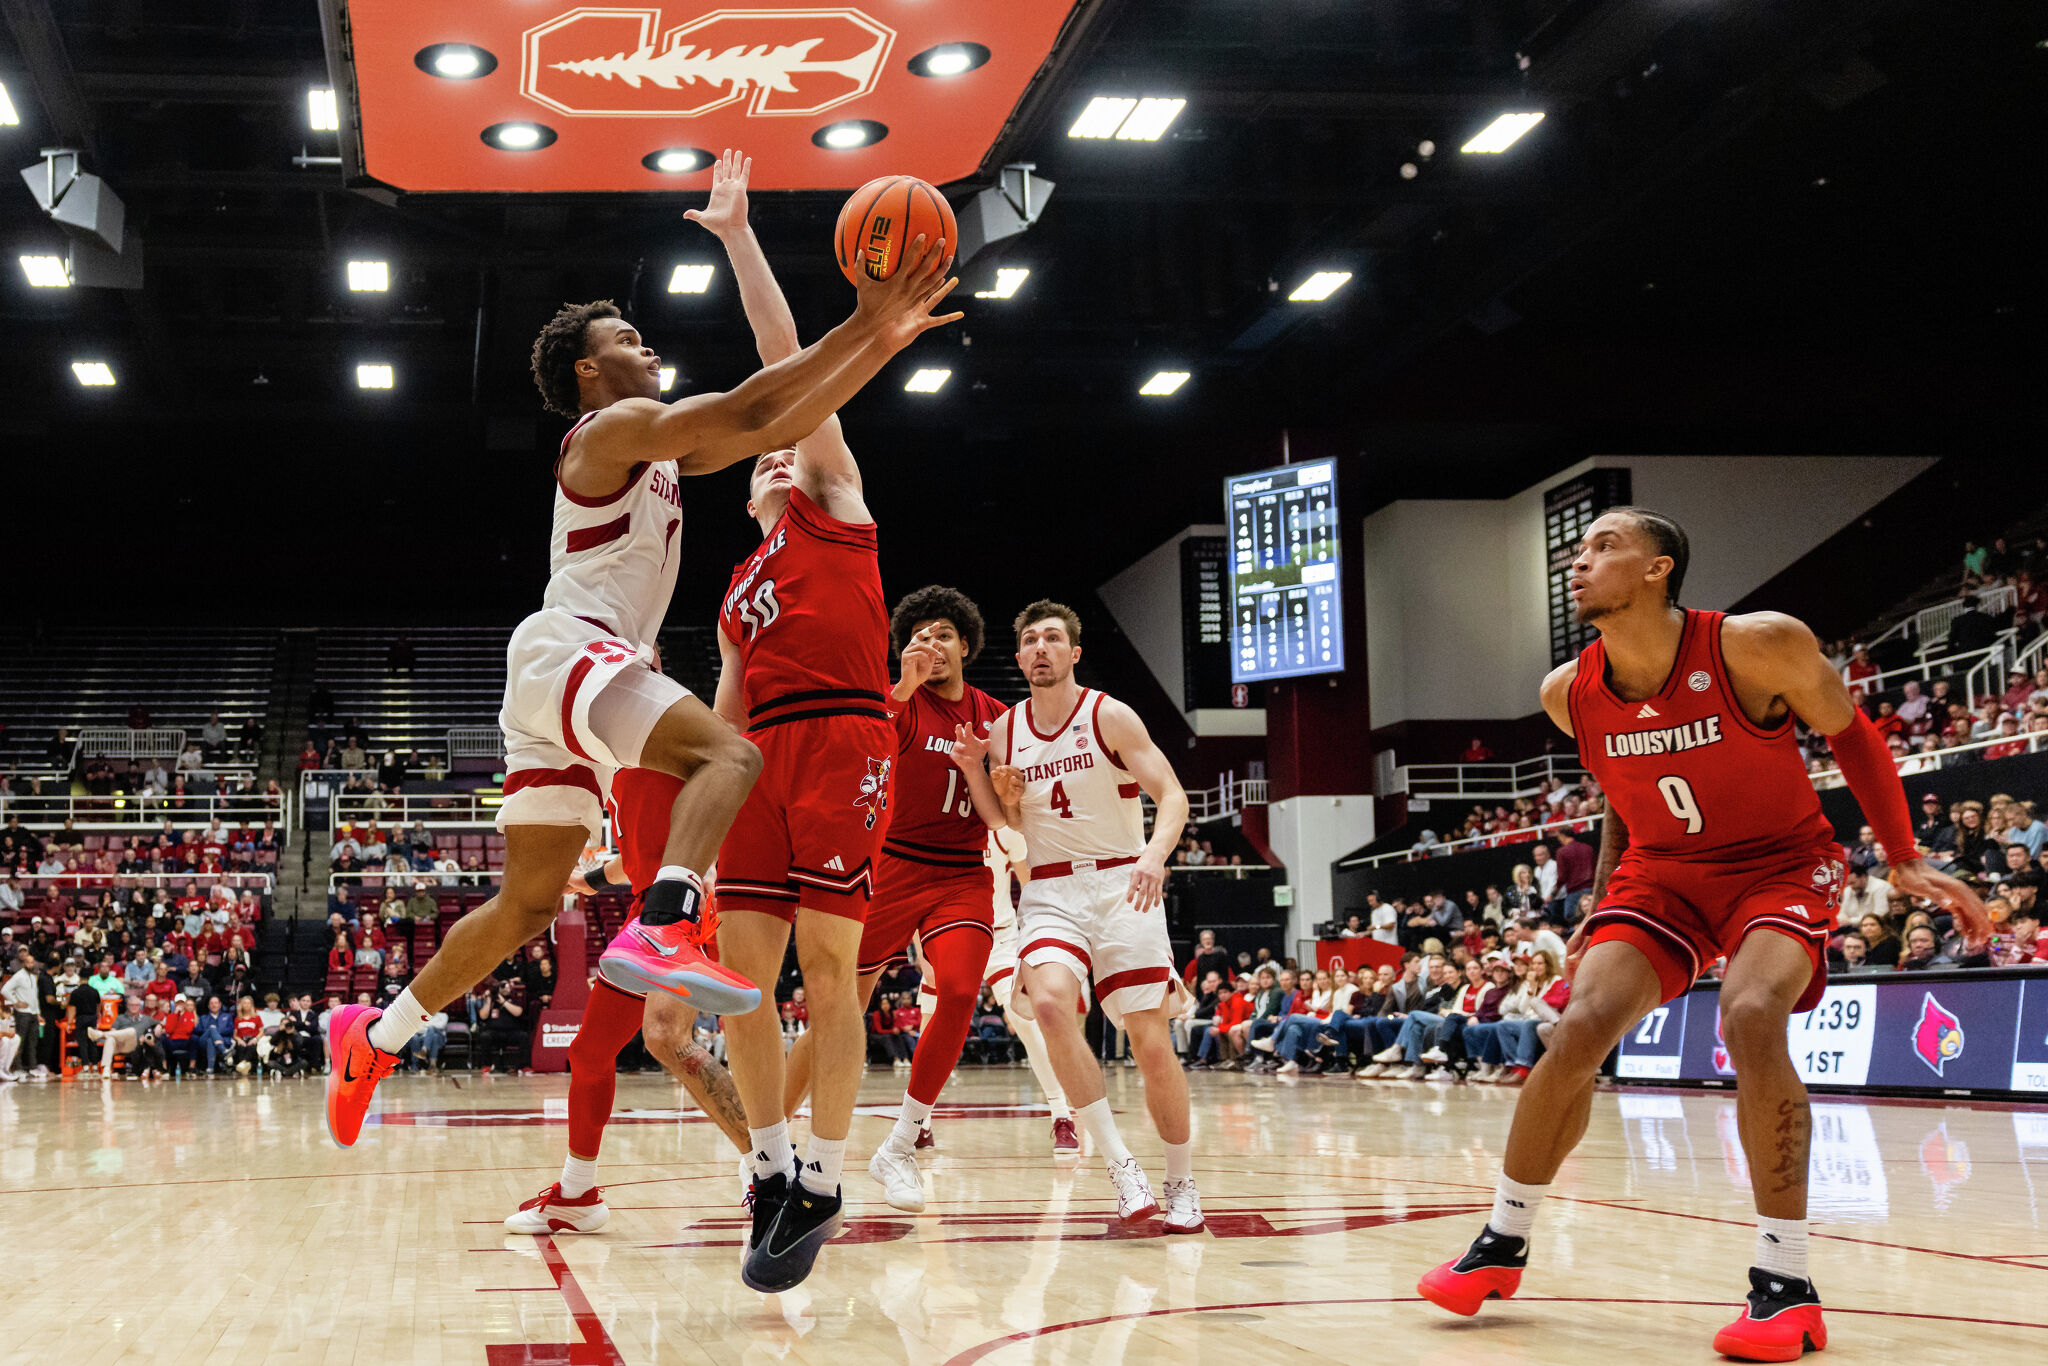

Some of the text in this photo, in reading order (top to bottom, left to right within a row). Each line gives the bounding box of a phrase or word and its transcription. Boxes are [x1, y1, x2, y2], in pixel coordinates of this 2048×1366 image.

[866, 216, 891, 281] ELITE
[1264, 509, 1272, 520] 7
[1290, 505, 1299, 516] 2
[1264, 522, 1273, 533] 2
[1291, 530, 1300, 541] 3
[724, 528, 786, 624] LOUISVLE
[1320, 600, 1329, 611] 2
[1268, 632, 1277, 643] 2
[1269, 656, 1277, 668] 7
[1605, 715, 1722, 757] LOUISVILLE
[1050, 780, 1074, 818] 4
[1657, 775, 1702, 835] 9
[1635, 1008, 1670, 1044] 27
[1805, 1051, 1844, 1074] 1ST
